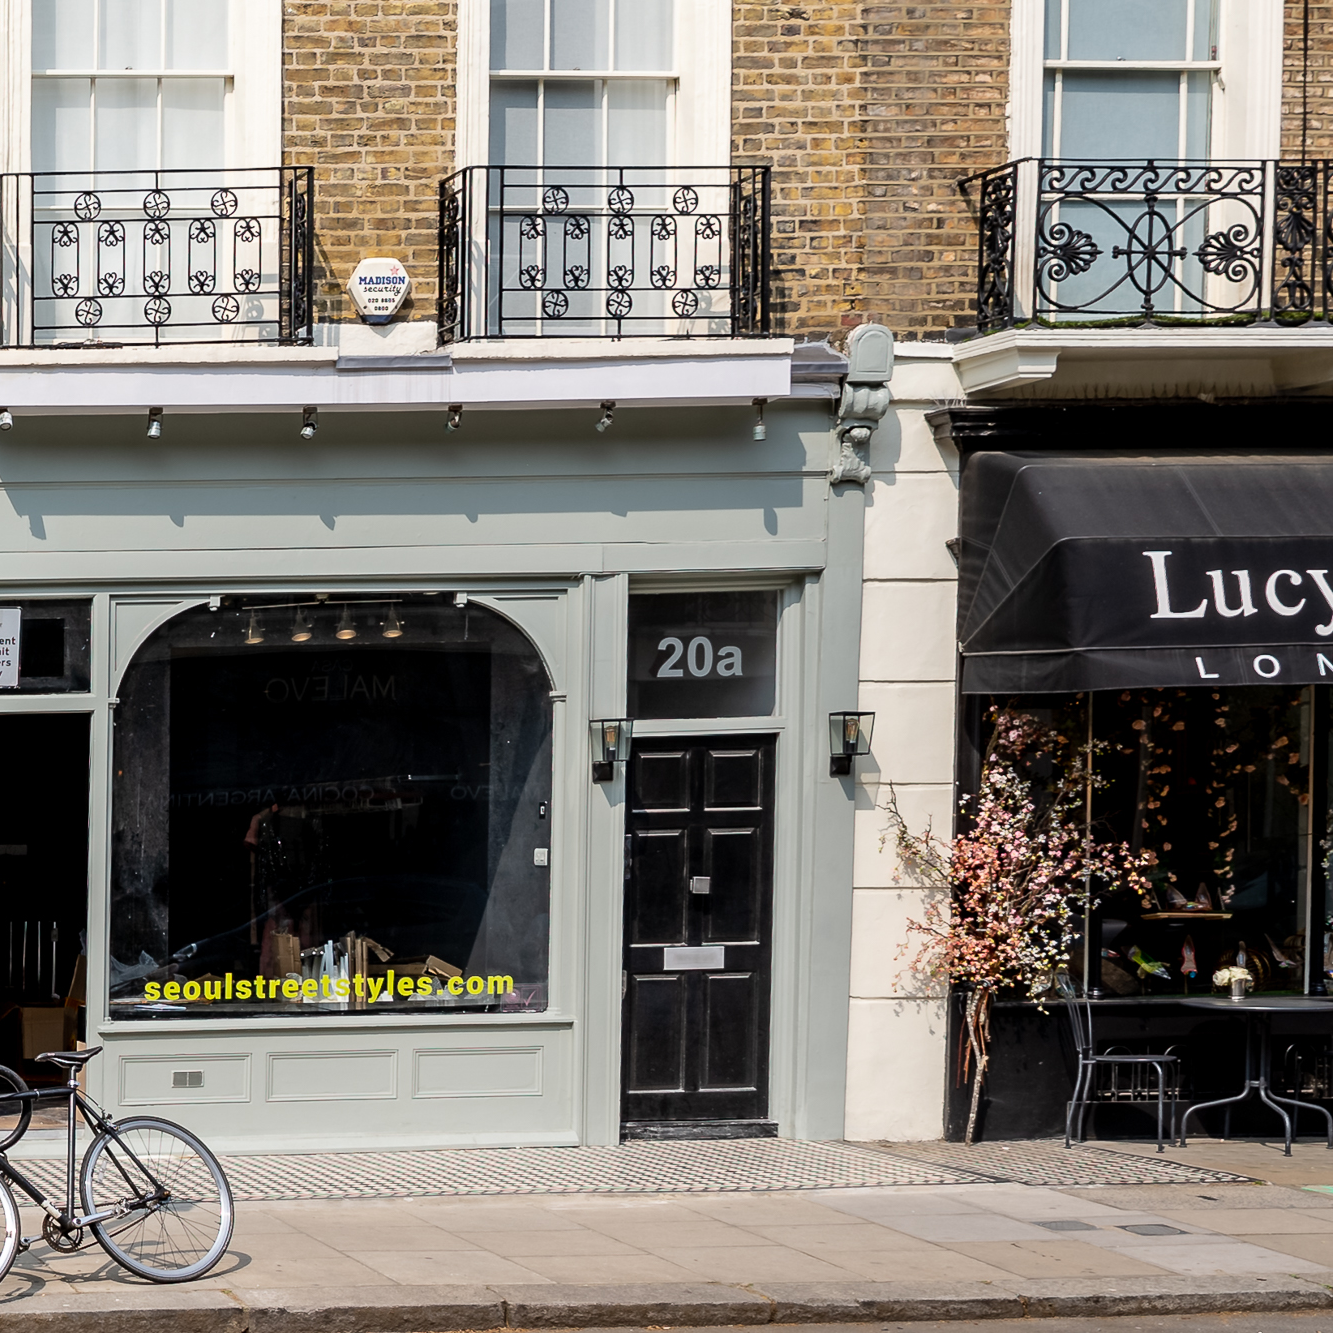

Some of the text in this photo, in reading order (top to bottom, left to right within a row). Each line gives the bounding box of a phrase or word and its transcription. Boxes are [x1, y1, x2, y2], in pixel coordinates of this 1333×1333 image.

[359, 276, 406, 285] MADISON
[363, 285, 401, 296] security
[1142, 550, 1333, 637] Lucy
[656, 636, 743, 677] 20a
[1195, 652, 1333, 679] LON
[144, 969, 514, 1003] seoulstreetstyles.com
